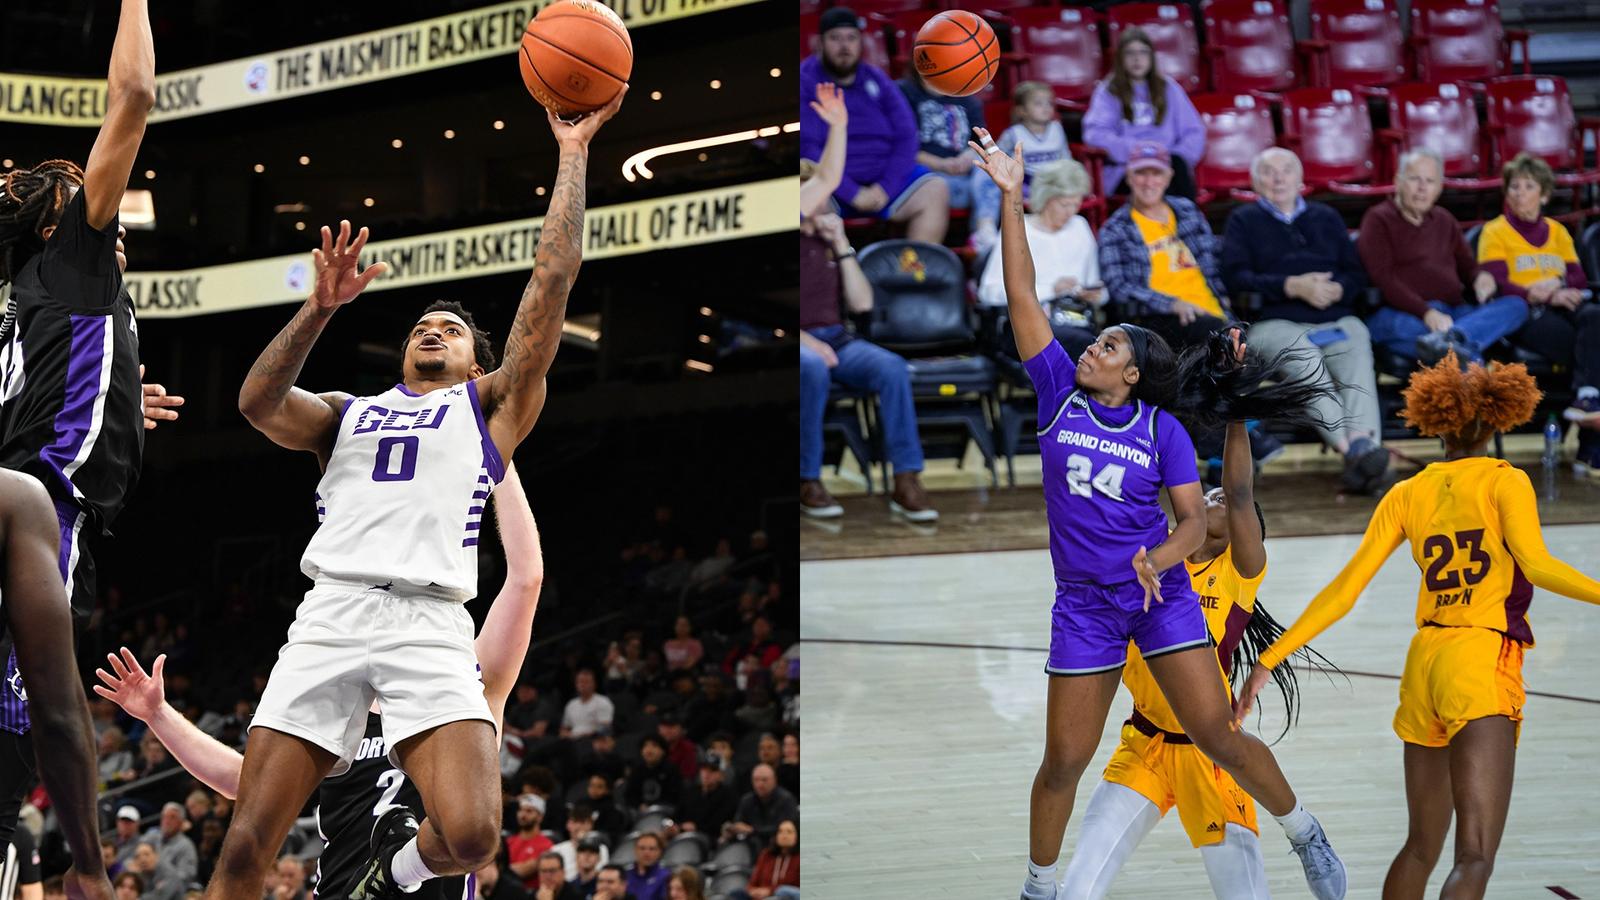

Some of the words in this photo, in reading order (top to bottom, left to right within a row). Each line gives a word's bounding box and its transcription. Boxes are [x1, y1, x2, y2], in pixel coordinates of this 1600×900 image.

[276, 53, 312, 91] THE
[319, 31, 420, 83] NAISMITH
[428, 3, 541, 61] BASKETB
[0, 82, 108, 118] LANGEL
[454, 227, 542, 270] BASKETB
[588, 212, 640, 249] HALL
[650, 204, 678, 241] OF
[684, 194, 744, 236] FAME
[352, 405, 450, 436] GCU
[372, 435, 419, 482] 0
[1057, 430, 1099, 450] GRAND
[1099, 440, 1152, 469] CANYON
[1066, 453, 1126, 502] 24
[1423, 528, 1491, 592] 23
[1199, 595, 1220, 610] ATE
[373, 769, 406, 817] 2
